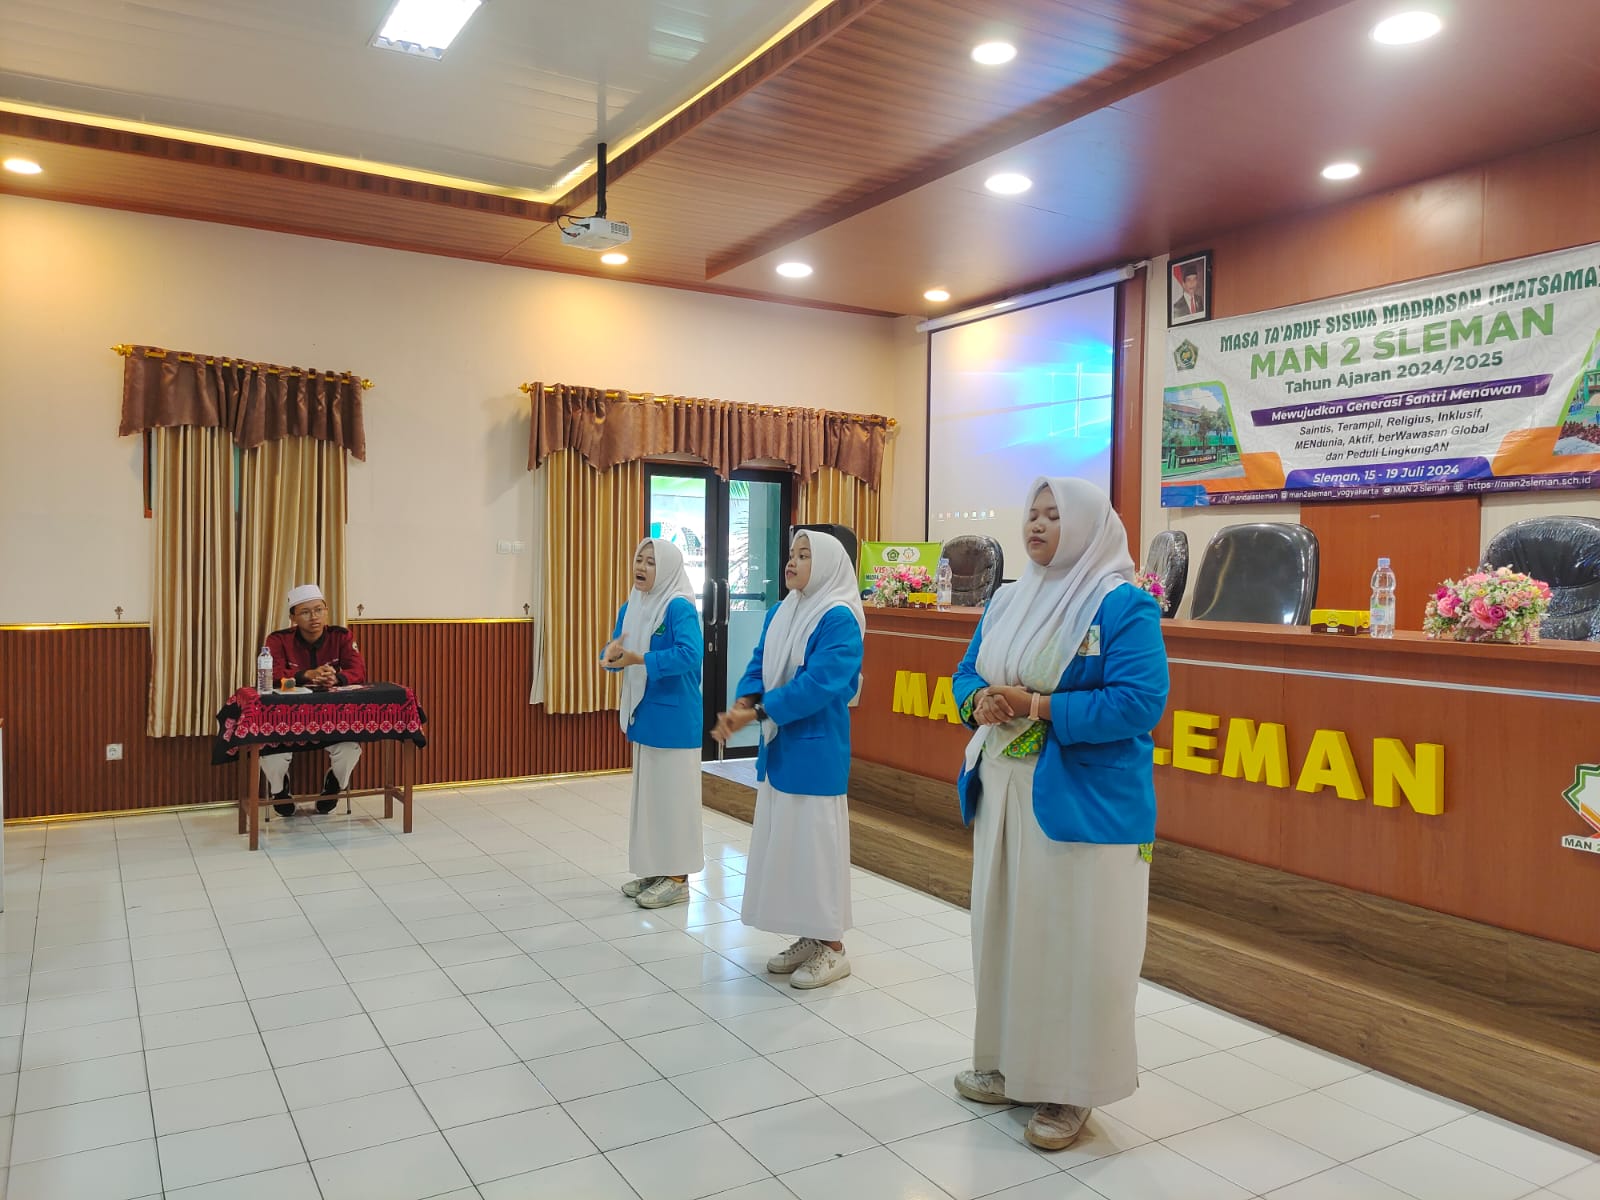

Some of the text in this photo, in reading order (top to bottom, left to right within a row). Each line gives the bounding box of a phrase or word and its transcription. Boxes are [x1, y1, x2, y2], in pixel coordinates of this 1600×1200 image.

[1220, 265, 1600, 352] MASA TA'ARUF SISWA MADRASAH (MATSAMA
[1250, 303, 1555, 380] MAN 2 SLEMAN
[1285, 351, 1503, 394] Tahun Ajaran 2024/2025
[1271, 384, 1521, 422] Mewujudkan Generasi Santri Menawan
[1300, 407, 1483, 435] Saintis, Terampil, Religius, Inklusif,
[1295, 423, 1490, 450] MENdunia, Aktif, berWawasan Global
[1326, 442, 1449, 461] dan Peduli LingkungAN
[1312, 472, 1361, 483] Sleman,
[1364, 470, 1376, 480] 15
[1385, 468, 1398, 479] 19
[1400, 465, 1424, 478] Juli
[1428, 464, 1460, 476] 2024
[1393, 485, 1411, 493] MAN
[1413, 484, 1419, 493] 2
[1420, 484, 1450, 492] Sleman
[1467, 475, 1591, 490] https://man2sleman.sch.id
[1565, 837, 1592, 850] MAN
